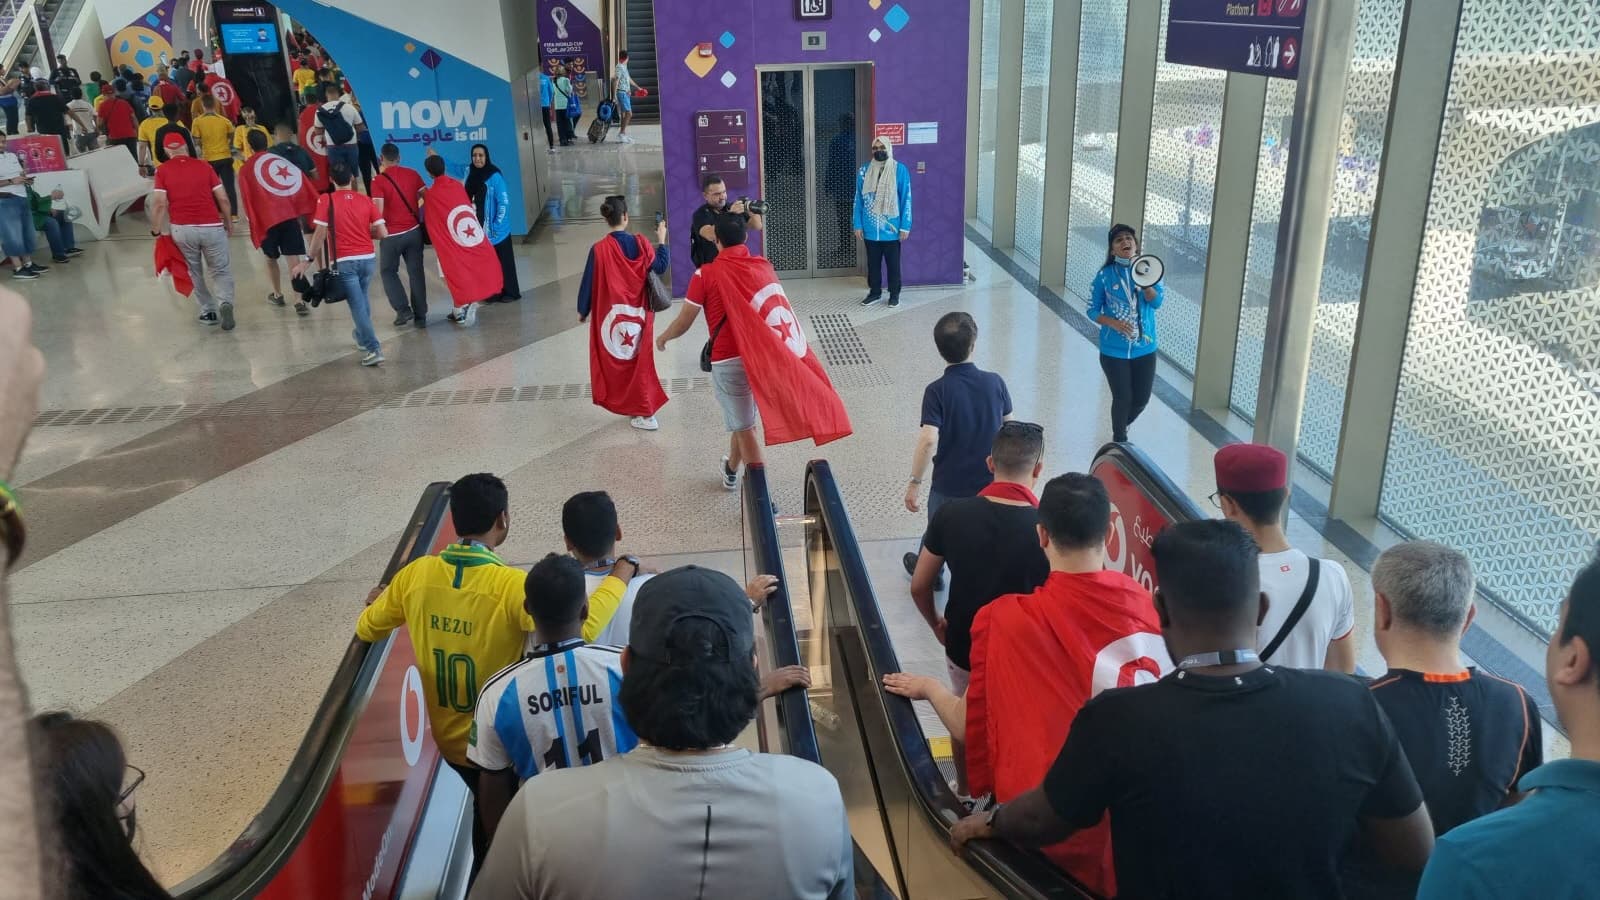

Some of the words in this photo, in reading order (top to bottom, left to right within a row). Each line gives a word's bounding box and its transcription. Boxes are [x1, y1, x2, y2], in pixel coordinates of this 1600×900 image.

[1226, 3, 1249, 16] Platform
[1250, 4, 1255, 16] 1
[381, 99, 488, 129] now
[736, 115, 743, 126] 1
[455, 128, 467, 142] is
[469, 127, 487, 141] all
[430, 614, 473, 637] REZU
[433, 648, 478, 713] 10
[527, 684, 603, 715] SORIFUL
